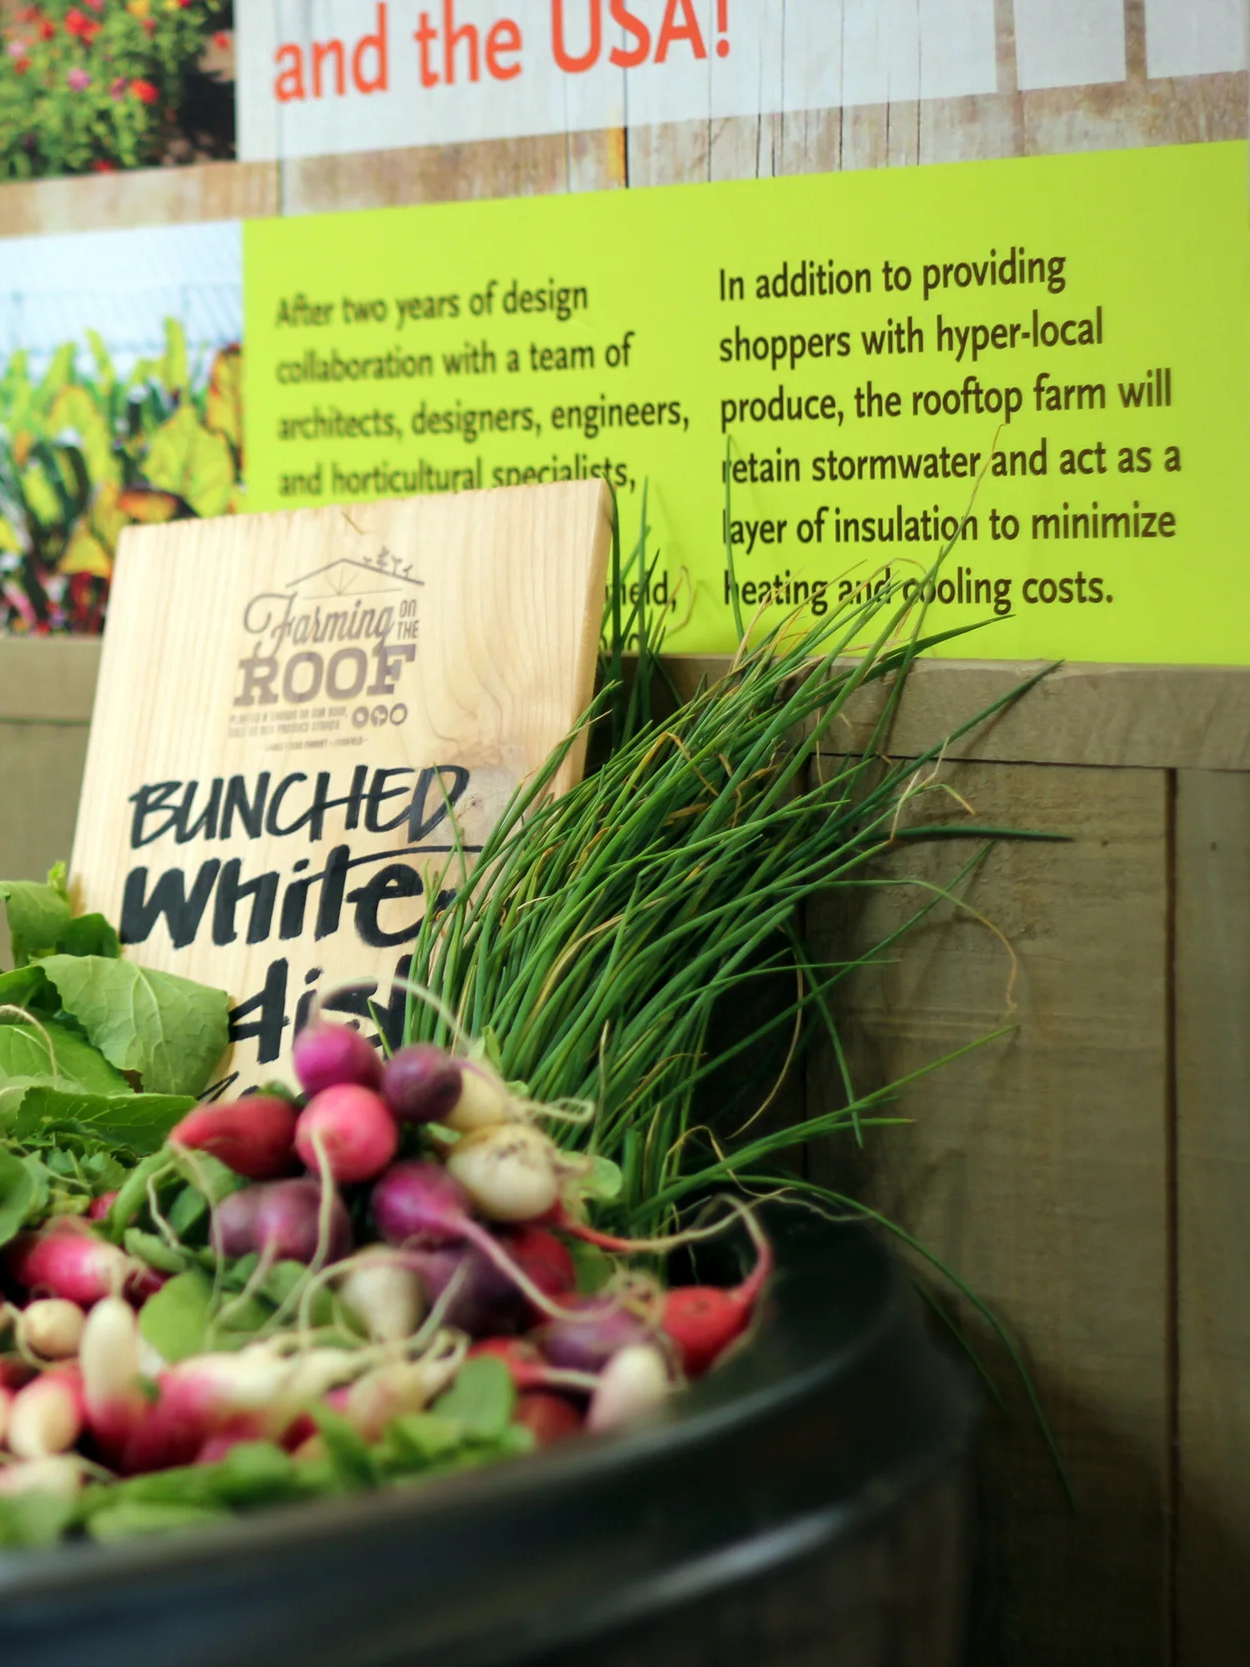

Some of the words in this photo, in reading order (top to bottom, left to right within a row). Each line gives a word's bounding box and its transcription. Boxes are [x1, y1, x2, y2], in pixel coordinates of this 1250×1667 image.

[273, 1, 390, 102] and
[413, 0, 523, 88] the
[551, 0, 731, 74] USA!
[719, 268, 744, 300] In
[755, 260, 872, 299] addition
[882, 260, 911, 292] to
[923, 246, 1066, 300] providing
[276, 294, 334, 328] After
[342, 298, 387, 325] two
[396, 291, 460, 330] years
[469, 279, 499, 317] of
[502, 278, 588, 321] design
[276, 347, 434, 385] collaboration
[442, 339, 496, 375] with
[506, 349, 520, 373] a
[530, 342, 595, 371] team
[605, 332, 636, 367] of
[719, 325, 851, 370] shoppers
[861, 317, 924, 355] with
[936, 306, 1103, 363] hyper-local
[277, 404, 402, 441] architects,
[411, 399, 542, 443] designers,
[551, 394, 689, 438] engineers,
[721, 384, 845, 433] produce,
[854, 381, 901, 417] the
[912, 375, 1023, 423] rooftop
[1034, 373, 1106, 411] farm
[1118, 368, 1172, 406] will
[279, 463, 323, 496] and
[331, 456, 482, 493] horticultural
[492, 453, 636, 491] specialists,
[722, 447, 800, 483] retain
[812, 447, 981, 481] stormwater
[991, 437, 1047, 477] and
[1060, 442, 1107, 474] act
[1118, 446, 1151, 474] as
[1164, 445, 1182, 472] a
[723, 508, 787, 555] layer
[797, 506, 829, 543] of
[835, 505, 978, 542] insulation
[989, 509, 1019, 541] to
[1032, 501, 1177, 540] minimize
[724, 569, 828, 615] heating
[839, 568, 892, 604] and
[902, 567, 1012, 616] cooling
[1022, 571, 1114, 604] costs.
[243, 592, 396, 659] Farming
[398, 620, 418, 640] THE
[233, 644, 416, 707] ROOF
[129, 764, 469, 850] BUNCHED
[119, 844, 484, 949] White
